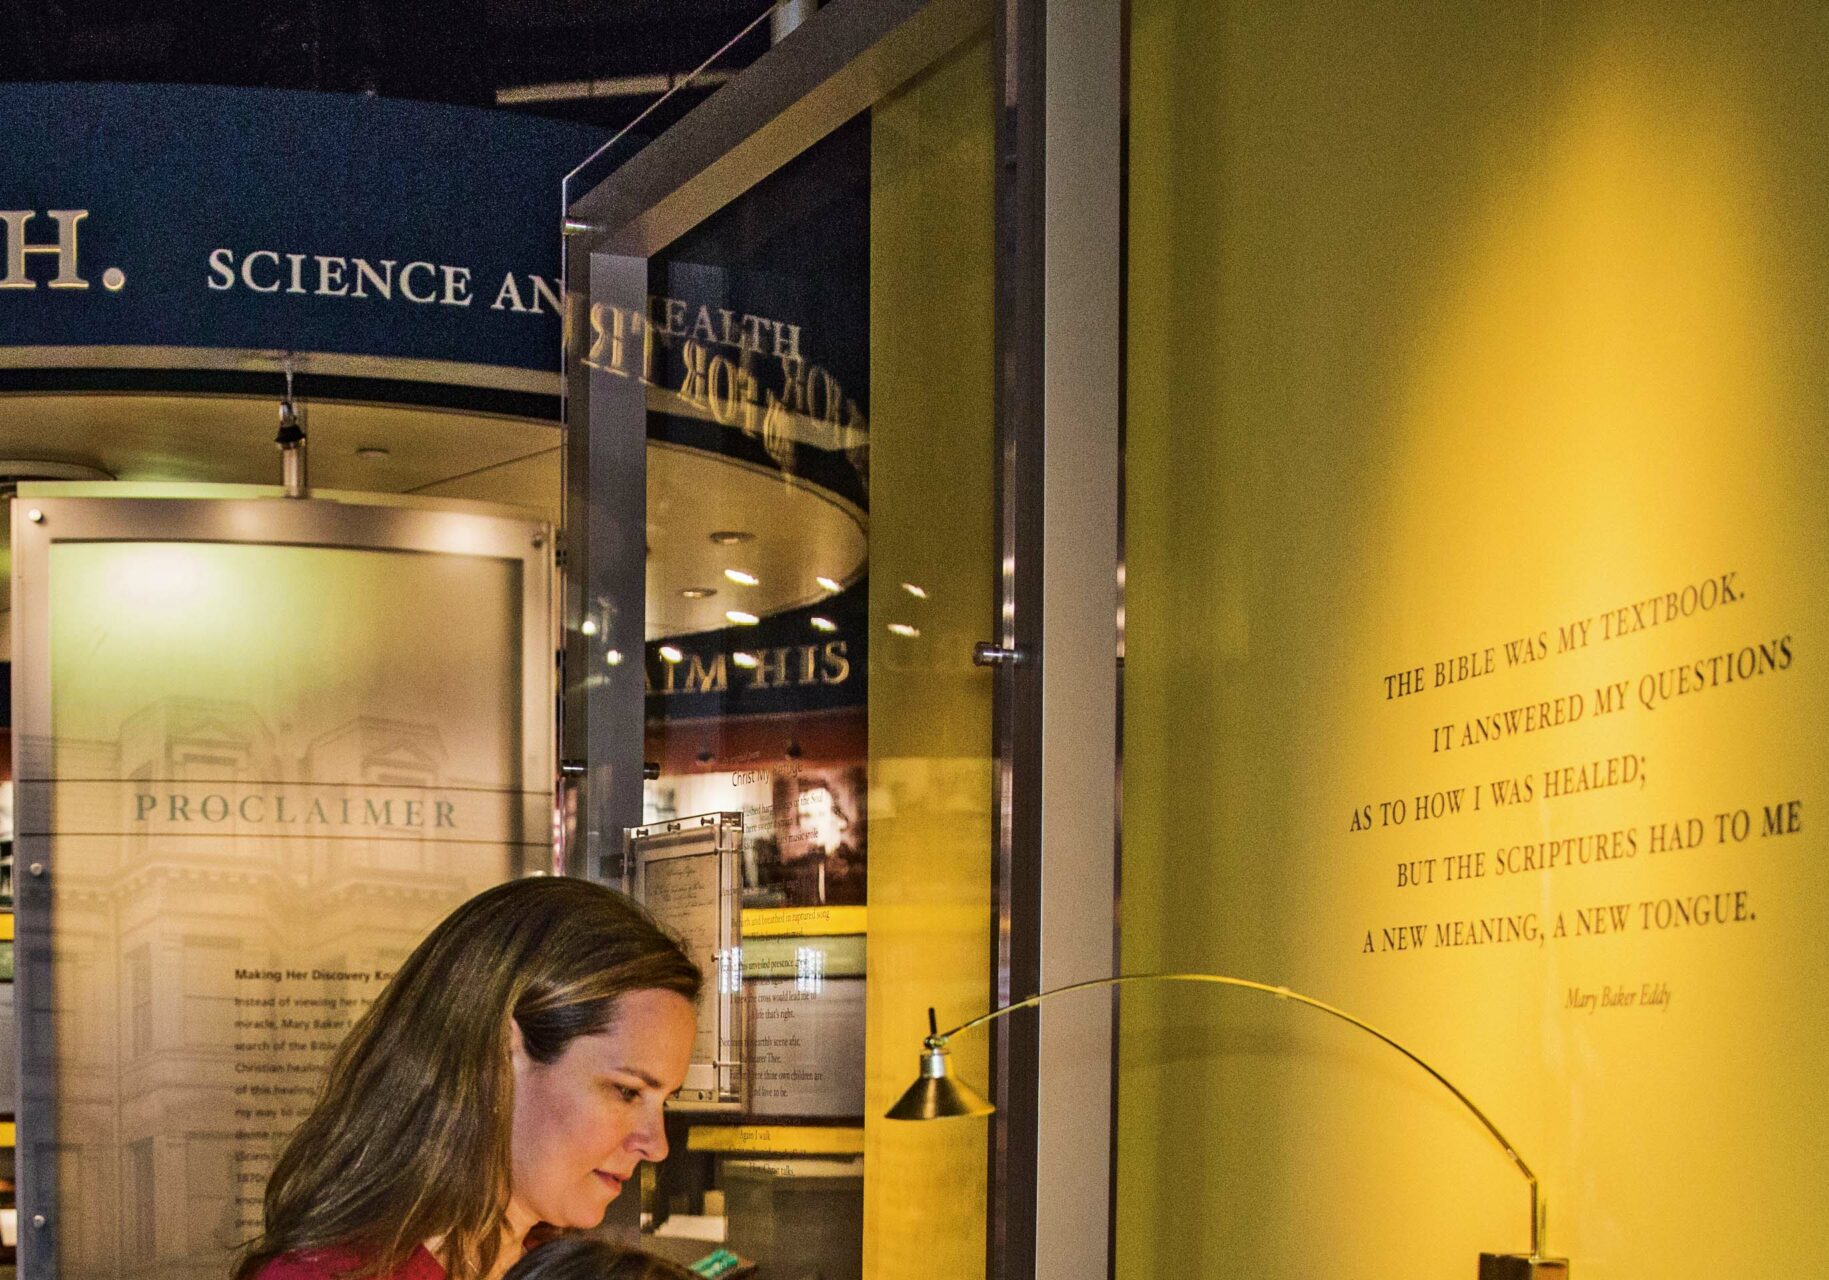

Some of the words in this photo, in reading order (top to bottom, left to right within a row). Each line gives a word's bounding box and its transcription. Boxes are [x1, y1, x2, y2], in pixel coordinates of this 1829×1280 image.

[0, 209, 125, 290] H.
[207, 248, 473, 307] SCIENCE
[750, 641, 850, 688] HIS
[1384, 667, 1424, 701] THE
[1435, 647, 1495, 689] BIBLE
[1505, 630, 1547, 668] WAS
[1557, 618, 1592, 653] MY
[1601, 570, 1745, 641] TEXTBOOK.
[1433, 727, 1454, 754] IT
[1460, 692, 1584, 748] ANSWERED
[1593, 681, 1629, 718] MY
[1638, 633, 1793, 708] QUESTIONS
[732, 770, 755, 787] Christ
[1350, 804, 1372, 833] AS
[1380, 799, 1406, 828] TO
[1415, 787, 1464, 820] HOW
[1474, 785, 1481, 811] I
[1491, 773, 1534, 808] WAS
[1543, 754, 1647, 799] HEALED;
[134, 793, 457, 828] PROCLAIMER
[1397, 860, 1436, 888] BUT
[1444, 851, 1485, 882] THE
[1495, 828, 1637, 876] SCRIPTURES
[1649, 817, 1703, 855] HAD
[1715, 808, 1750, 843] TO
[1761, 800, 1802, 837] ME
[1362, 929, 1374, 954] A
[1382, 924, 1427, 952] NEW
[1435, 913, 1546, 948] MEANING,
[1553, 912, 1567, 939] A
[1576, 904, 1630, 936] NEW
[1640, 890, 1757, 929] TONGUE.
[235, 969, 282, 983] Making
[286, 970, 307, 980] Her
[312, 970, 370, 983] Discovery
[1565, 986, 1598, 1014] Mary
[1601, 983, 1637, 1007] Baker
[1639, 981, 1671, 1008] Eddy
